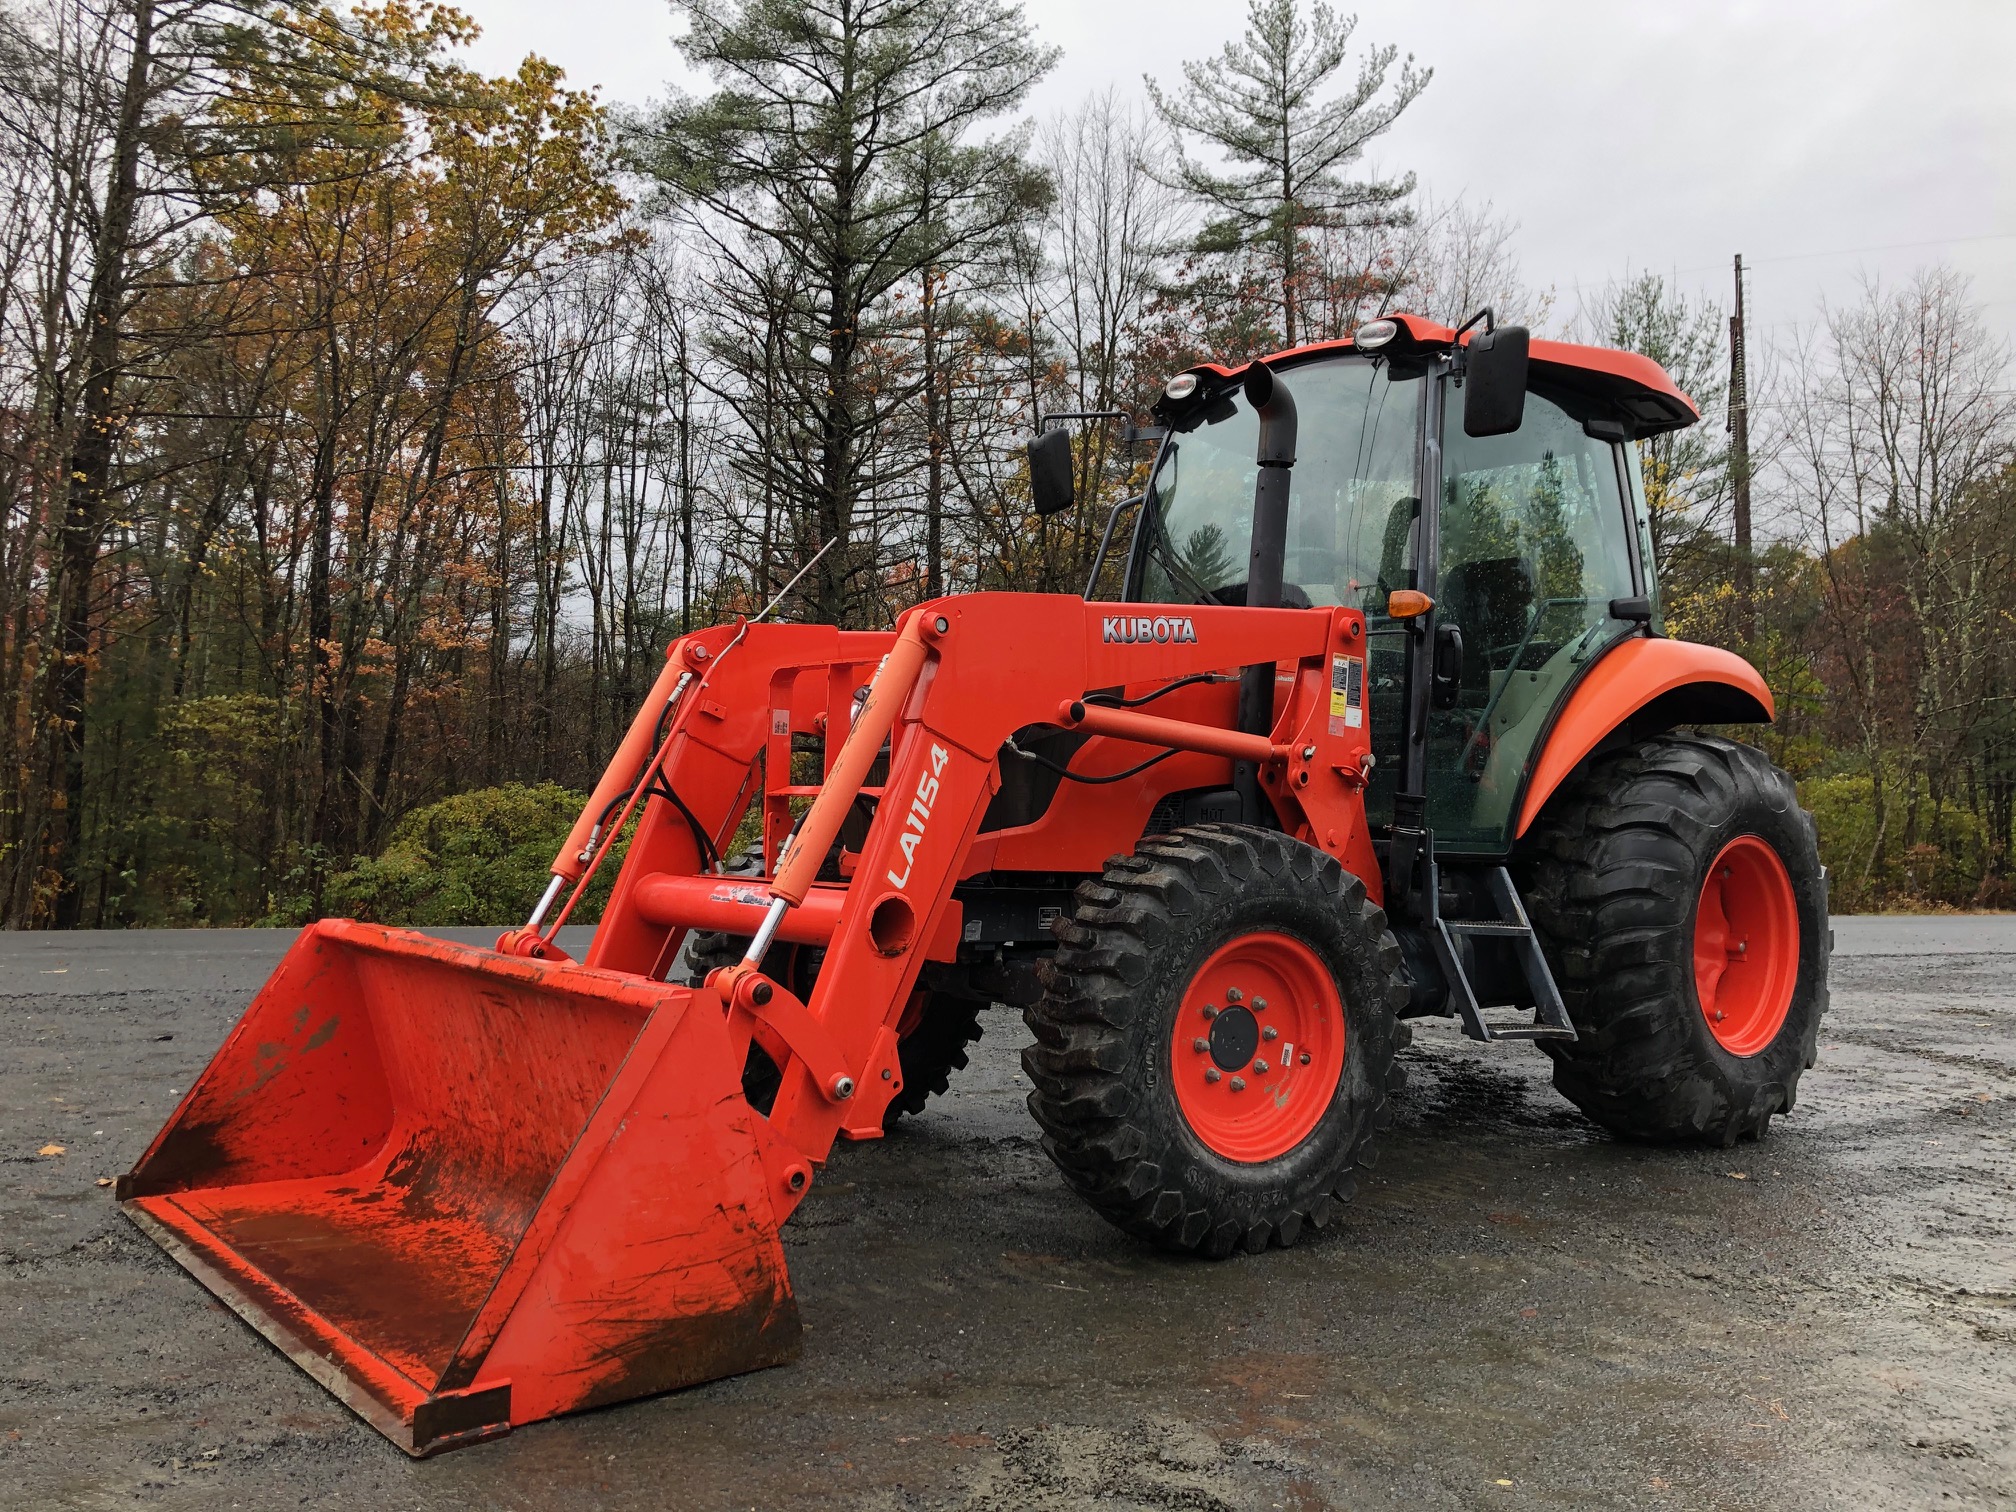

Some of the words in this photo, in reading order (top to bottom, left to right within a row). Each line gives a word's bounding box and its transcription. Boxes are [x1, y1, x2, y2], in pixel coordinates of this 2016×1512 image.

[1102, 616, 1197, 643] KUBOTA
[887, 743, 948, 889] LA1154
[1340, 926, 1383, 1017] TITAN
